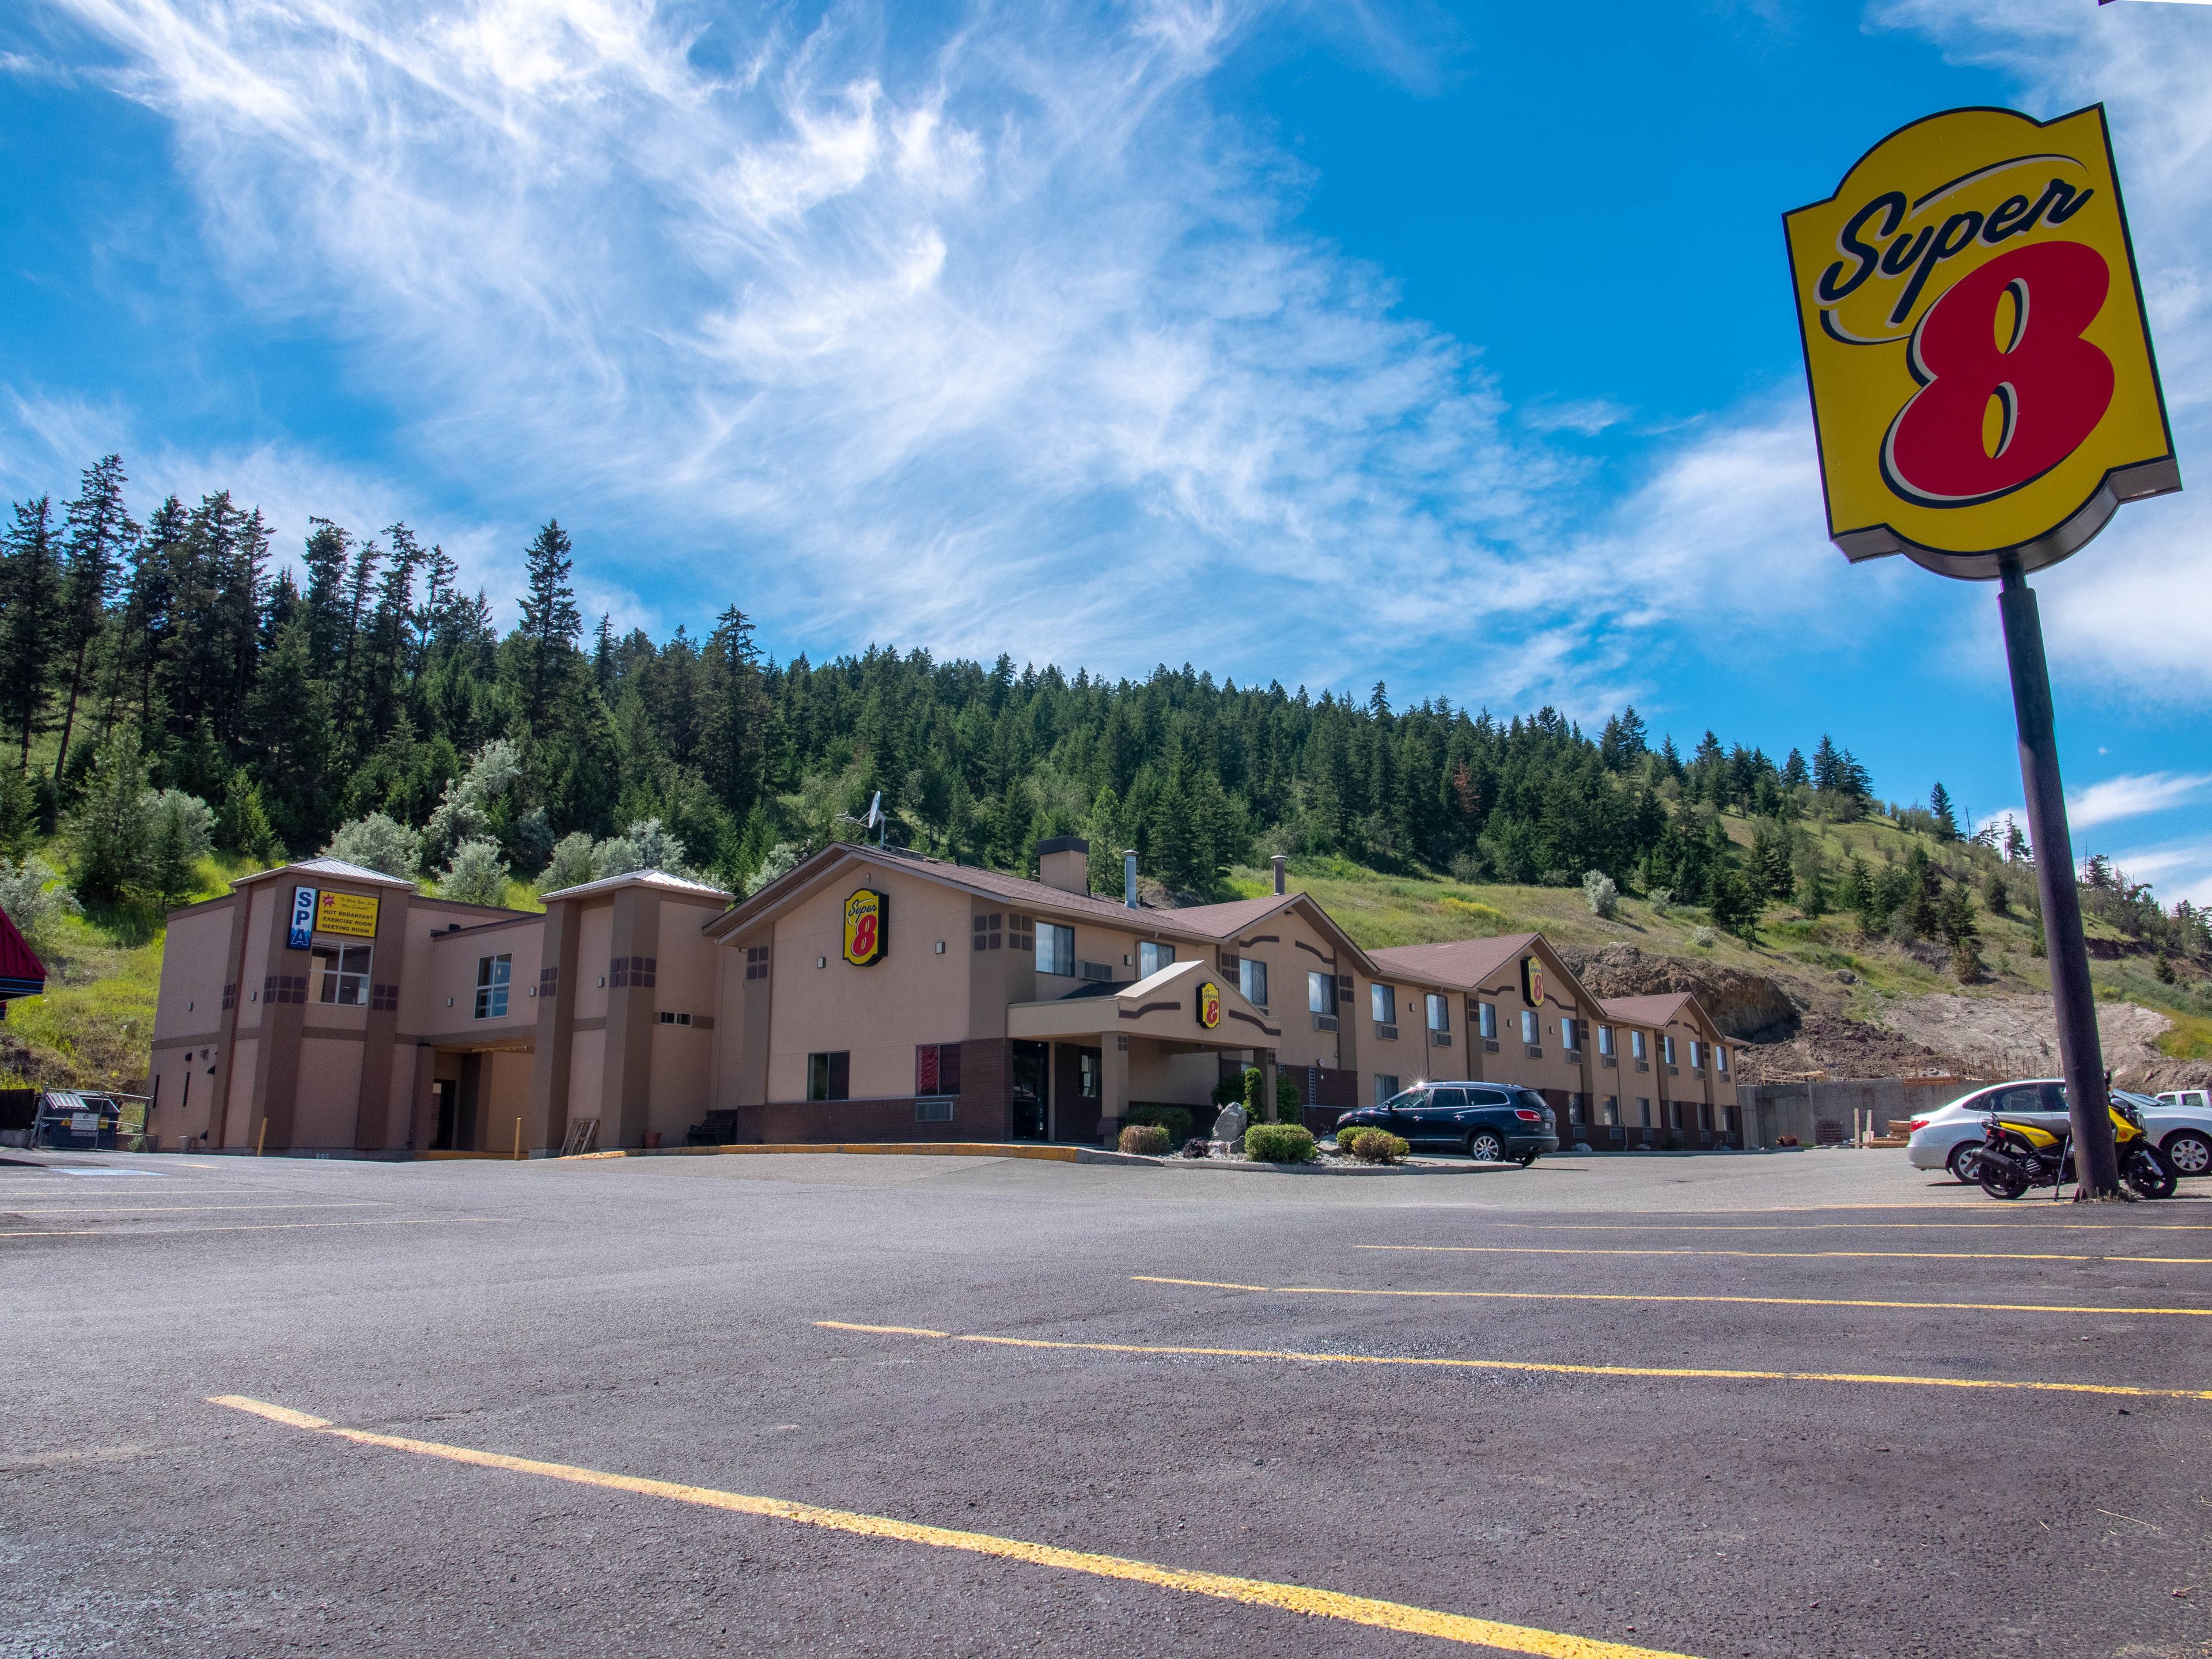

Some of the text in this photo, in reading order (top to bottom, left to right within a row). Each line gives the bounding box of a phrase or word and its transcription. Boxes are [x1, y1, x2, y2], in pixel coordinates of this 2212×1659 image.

[1814, 178, 2095, 328] Super
[1878, 240, 2115, 509] 8
[291, 891, 312, 946] SPA
[323, 916, 353, 925] EXERCISE
[338, 911, 374, 920] BREAKFAST
[848, 899, 877, 923] Super
[851, 914, 877, 957] 8
[1204, 989, 1218, 1003] Super
[1533, 975, 1542, 1001] 8
[1206, 1001, 1218, 1024] 8
